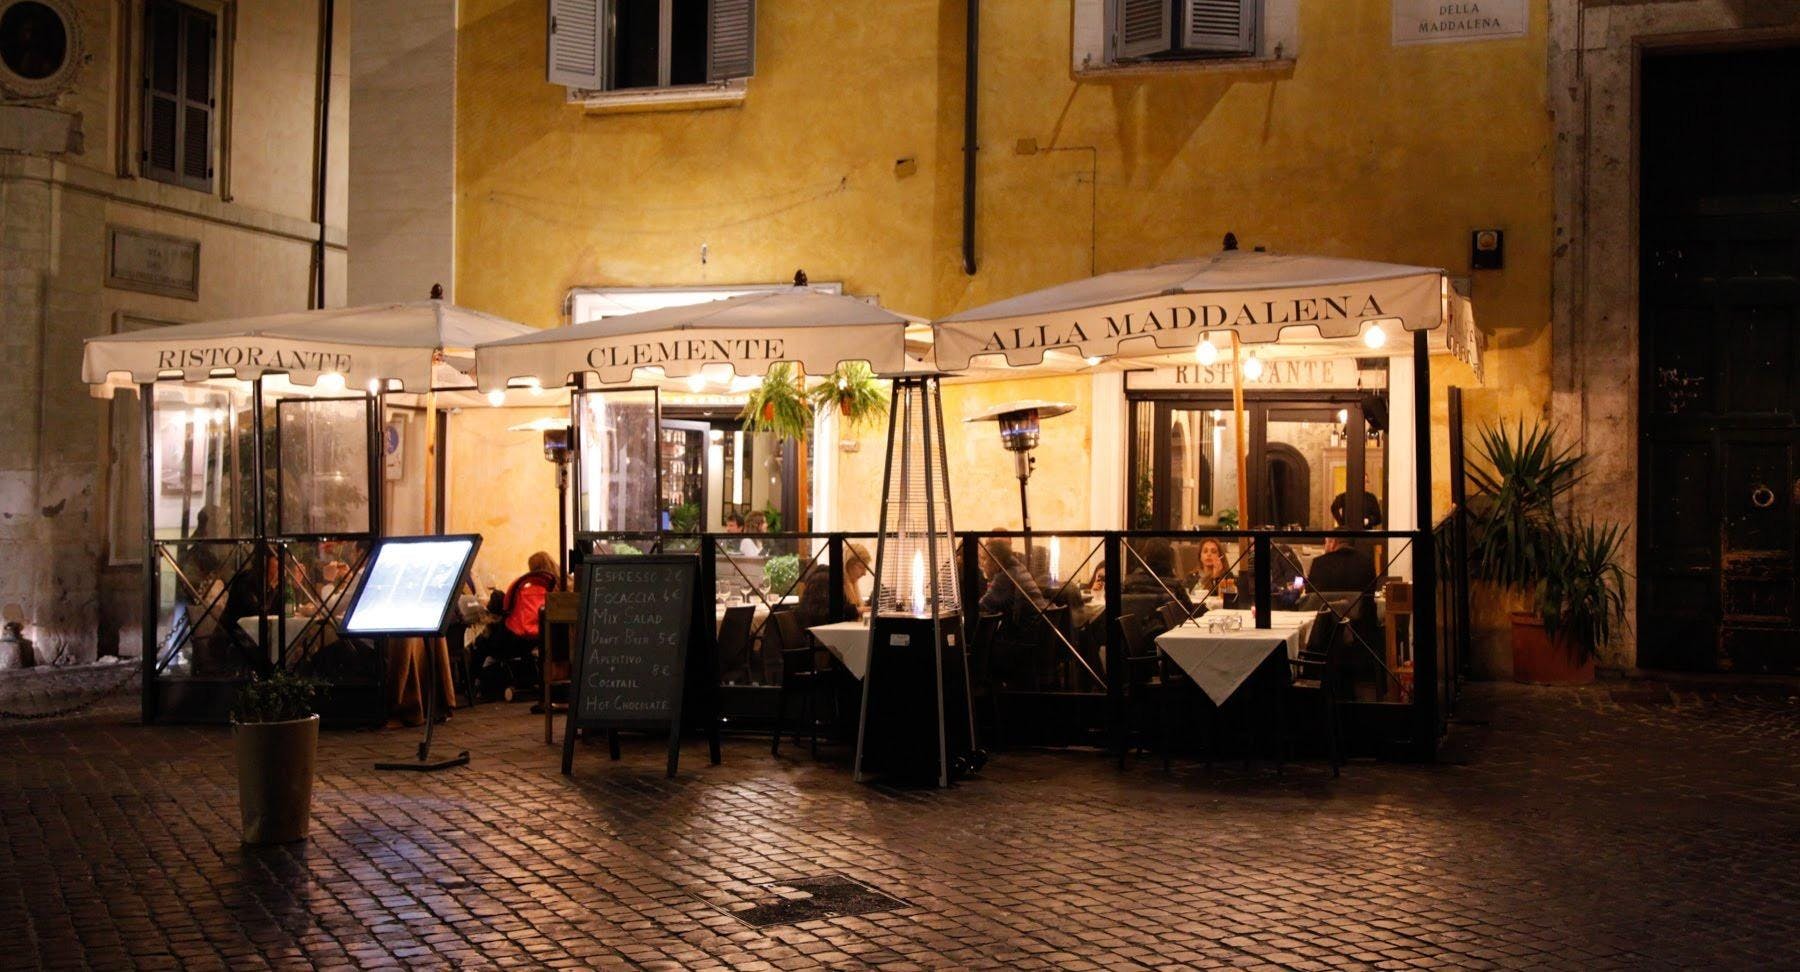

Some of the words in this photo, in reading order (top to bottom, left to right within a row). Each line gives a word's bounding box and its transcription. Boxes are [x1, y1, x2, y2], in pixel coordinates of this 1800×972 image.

[1439, 4, 1480, 16] DELLA
[1418, 18, 1500, 33] MADDALENA
[983, 321, 1088, 351] ALLA
[1104, 294, 1386, 338] MADDALENA
[158, 346, 351, 374] RISTORANTE
[586, 338, 785, 369] CLEMENTE
[1175, 360, 1335, 385] RISTANTE
[594, 567, 657, 583] ESPRESSO
[593, 586, 656, 604] FOCACCIA
[592, 608, 618, 625] MIX
[586, 696, 609, 712] HOT
